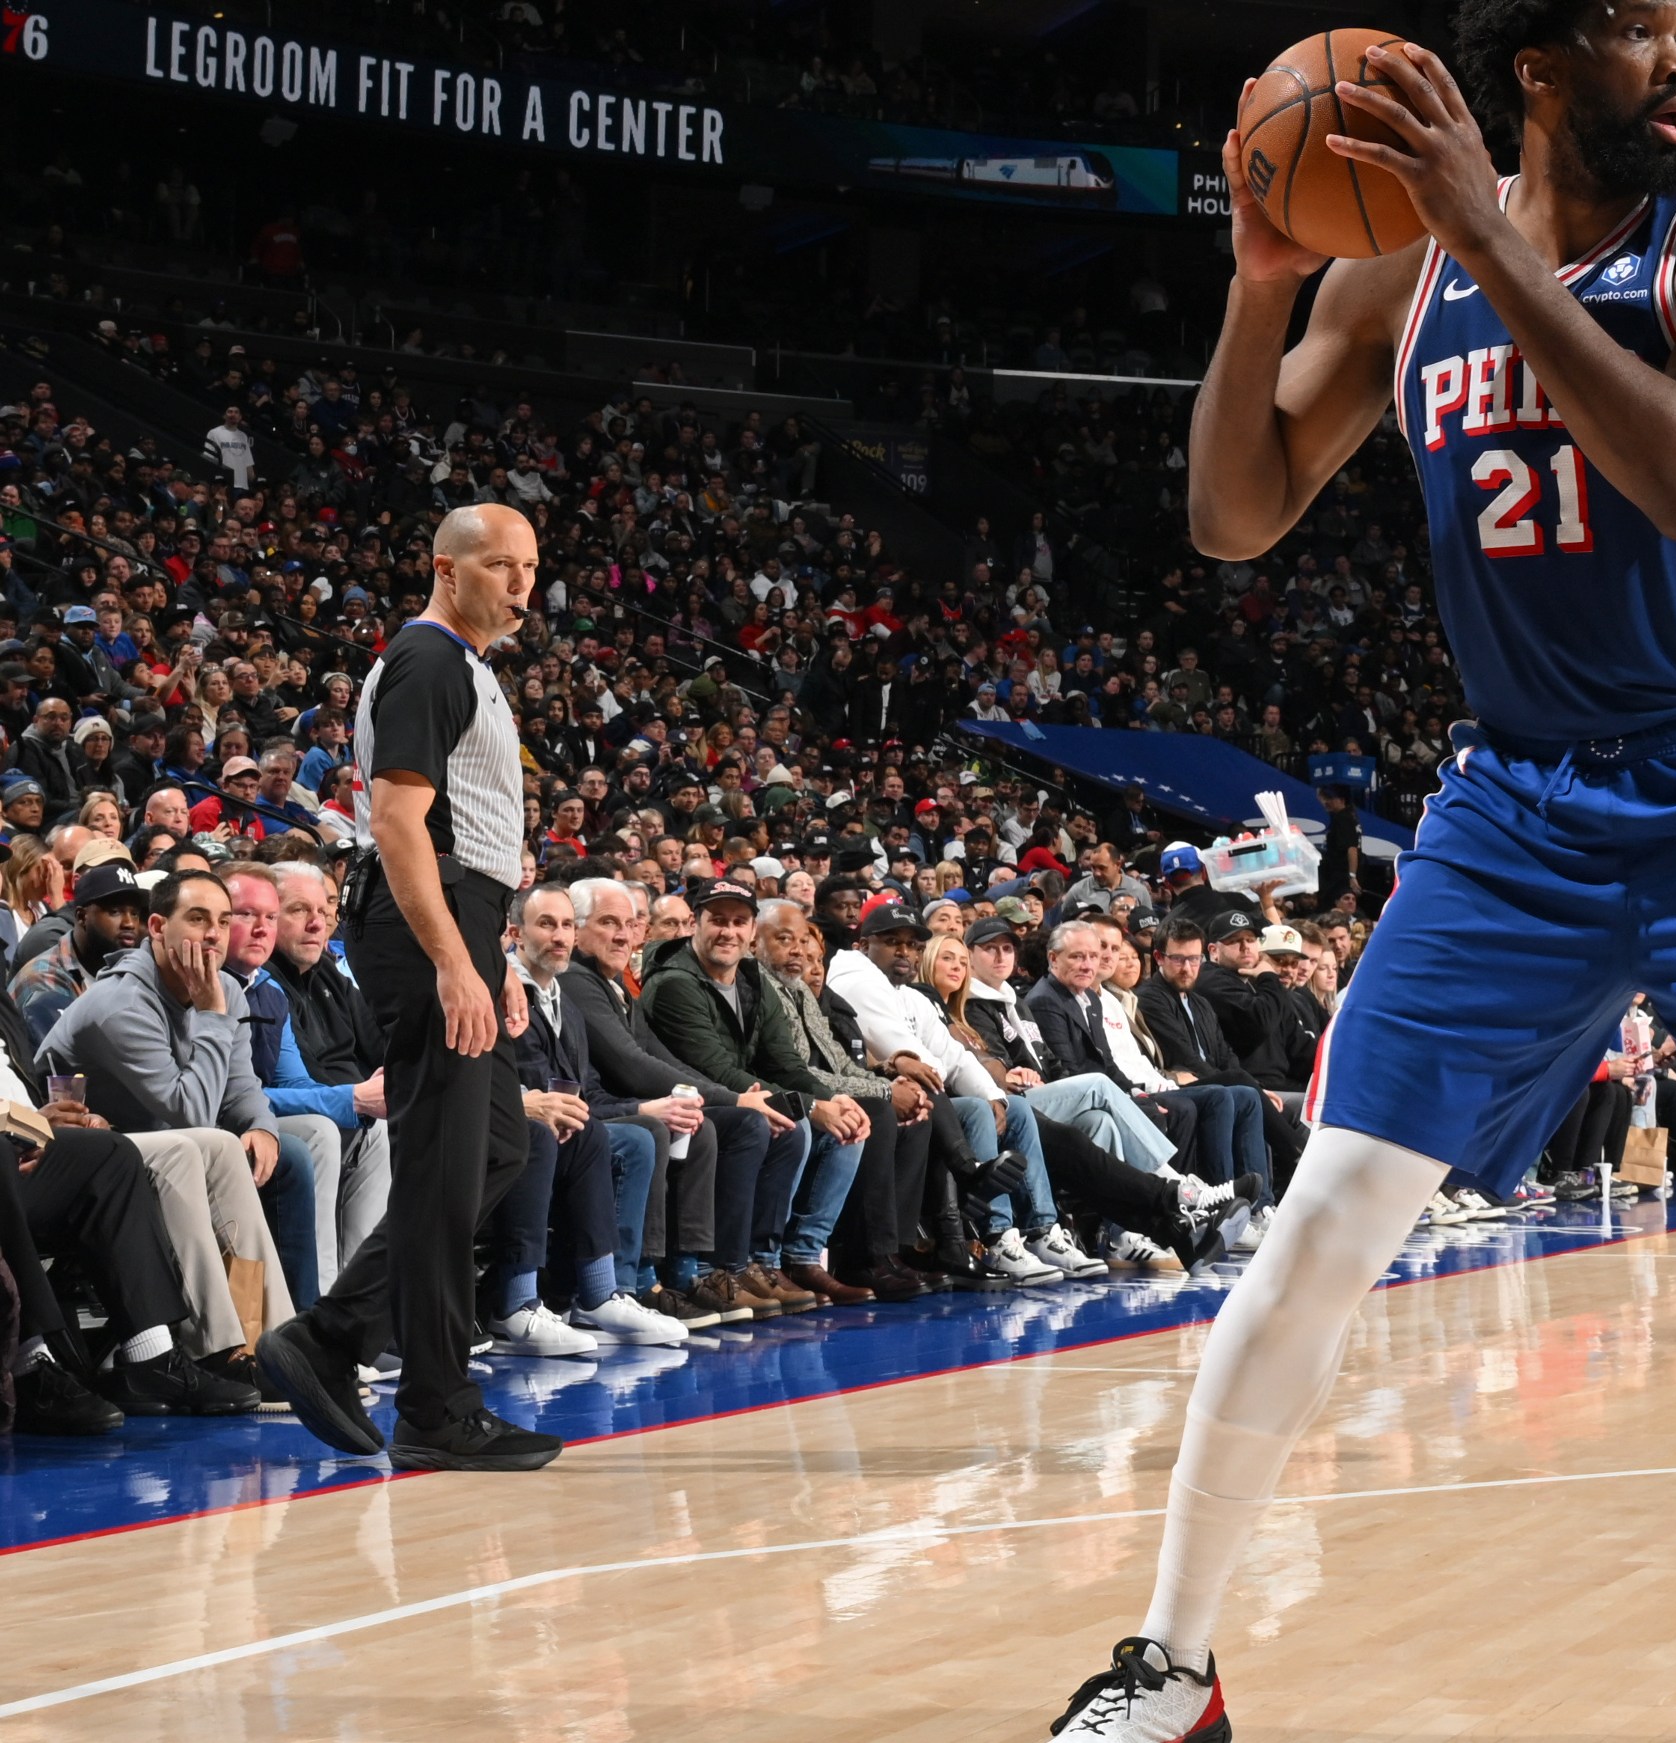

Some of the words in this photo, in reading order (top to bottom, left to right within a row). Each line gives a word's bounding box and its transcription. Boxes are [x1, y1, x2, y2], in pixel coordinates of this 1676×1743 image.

[3, 7, 48, 60] 76
[145, 17, 337, 107] LEGROOM
[359, 56, 415, 120] FIT
[433, 69, 502, 136] FOR
[522, 85, 546, 142] A
[568, 90, 724, 164] CENTER
[1582, 287, 1648, 303] crypto.com
[1470, 444, 1594, 559] 21
